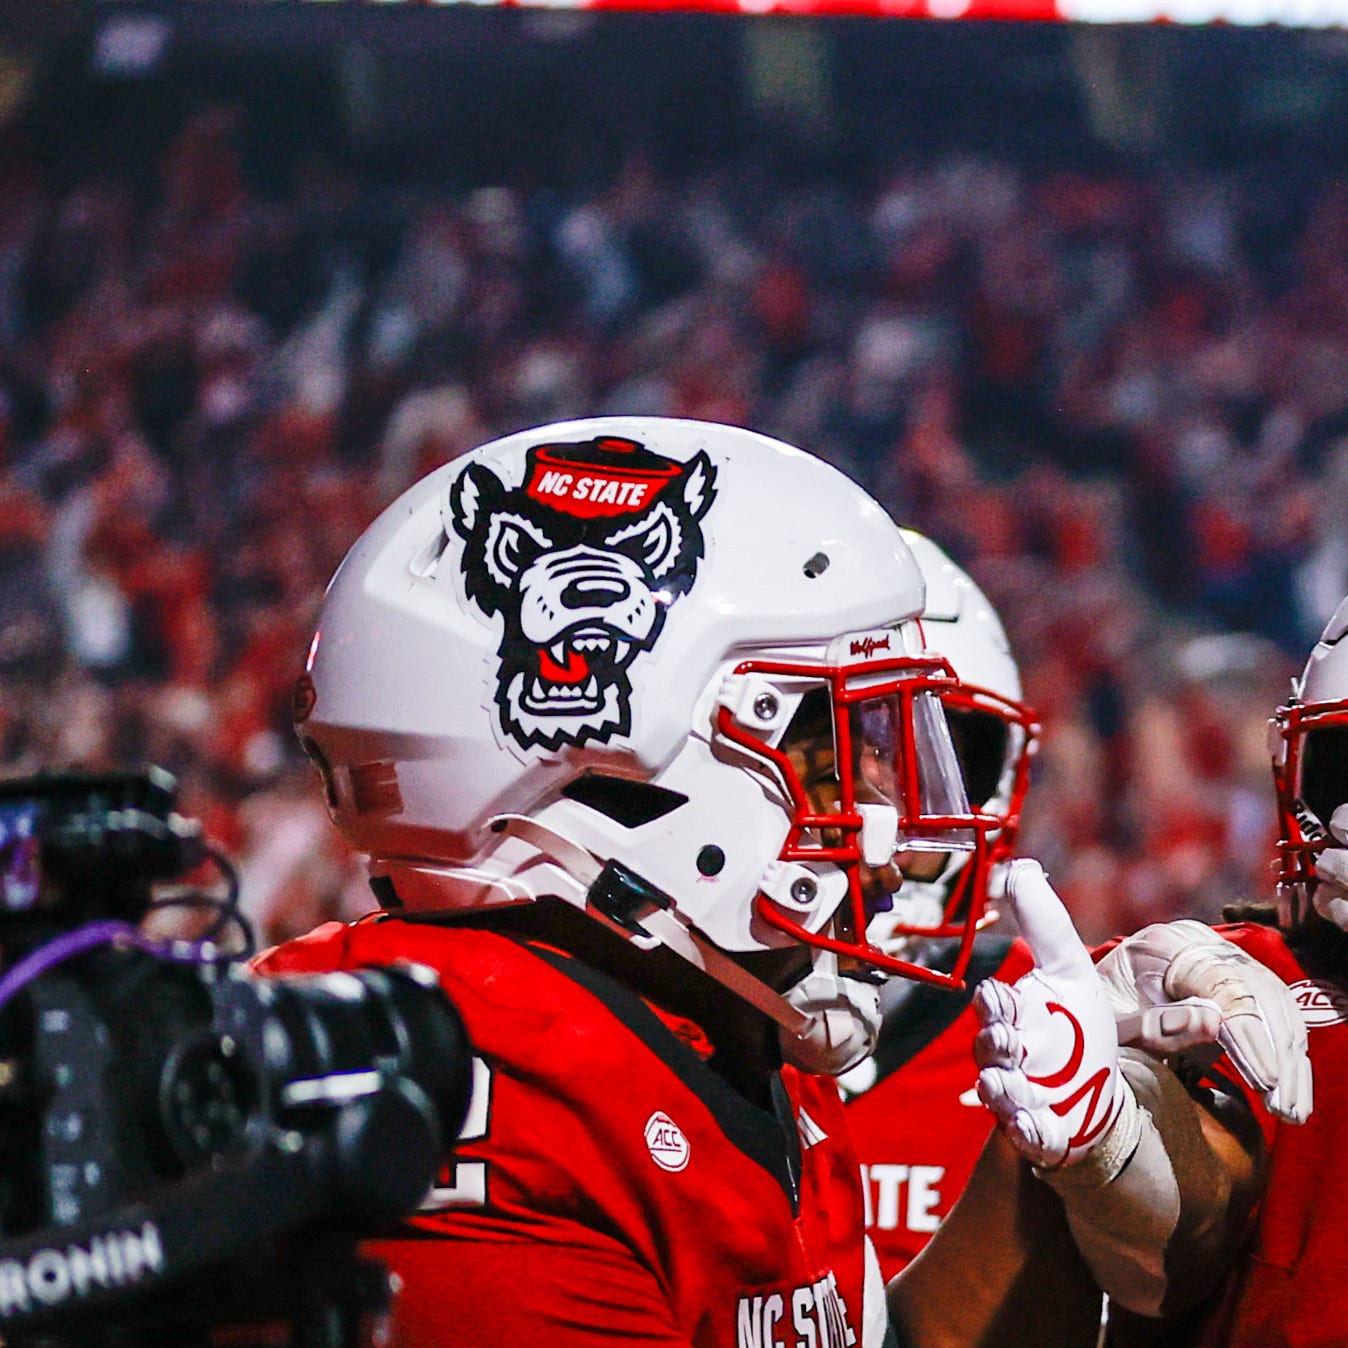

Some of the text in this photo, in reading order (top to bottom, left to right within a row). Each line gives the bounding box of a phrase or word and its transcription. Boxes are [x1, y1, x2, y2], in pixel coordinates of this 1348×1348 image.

[537, 471, 649, 506] NC STATE
[652, 1128, 682, 1148] ACC
